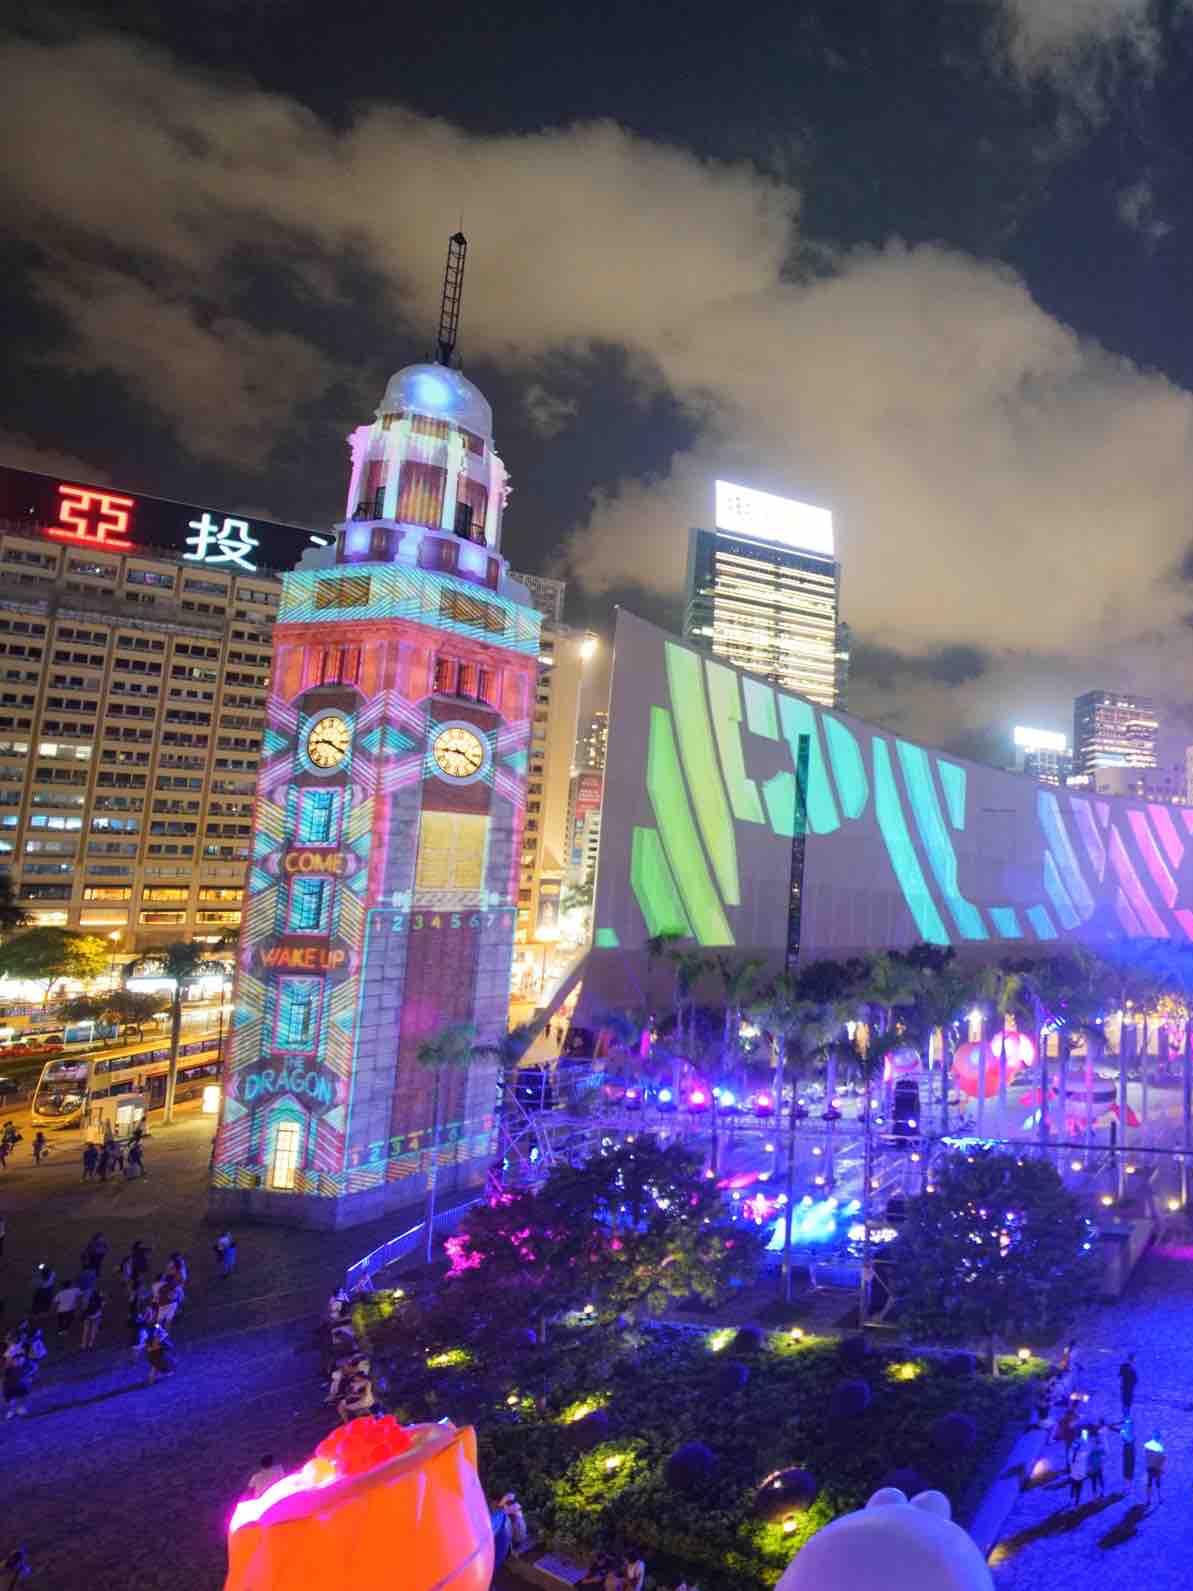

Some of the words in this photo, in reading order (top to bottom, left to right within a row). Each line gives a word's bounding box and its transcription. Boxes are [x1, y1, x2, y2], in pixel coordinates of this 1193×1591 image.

[285, 852, 345, 873] COME
[261, 947, 315, 968] WAKE
[318, 948, 345, 968] UP
[244, 1069, 332, 1104] DRAGON
